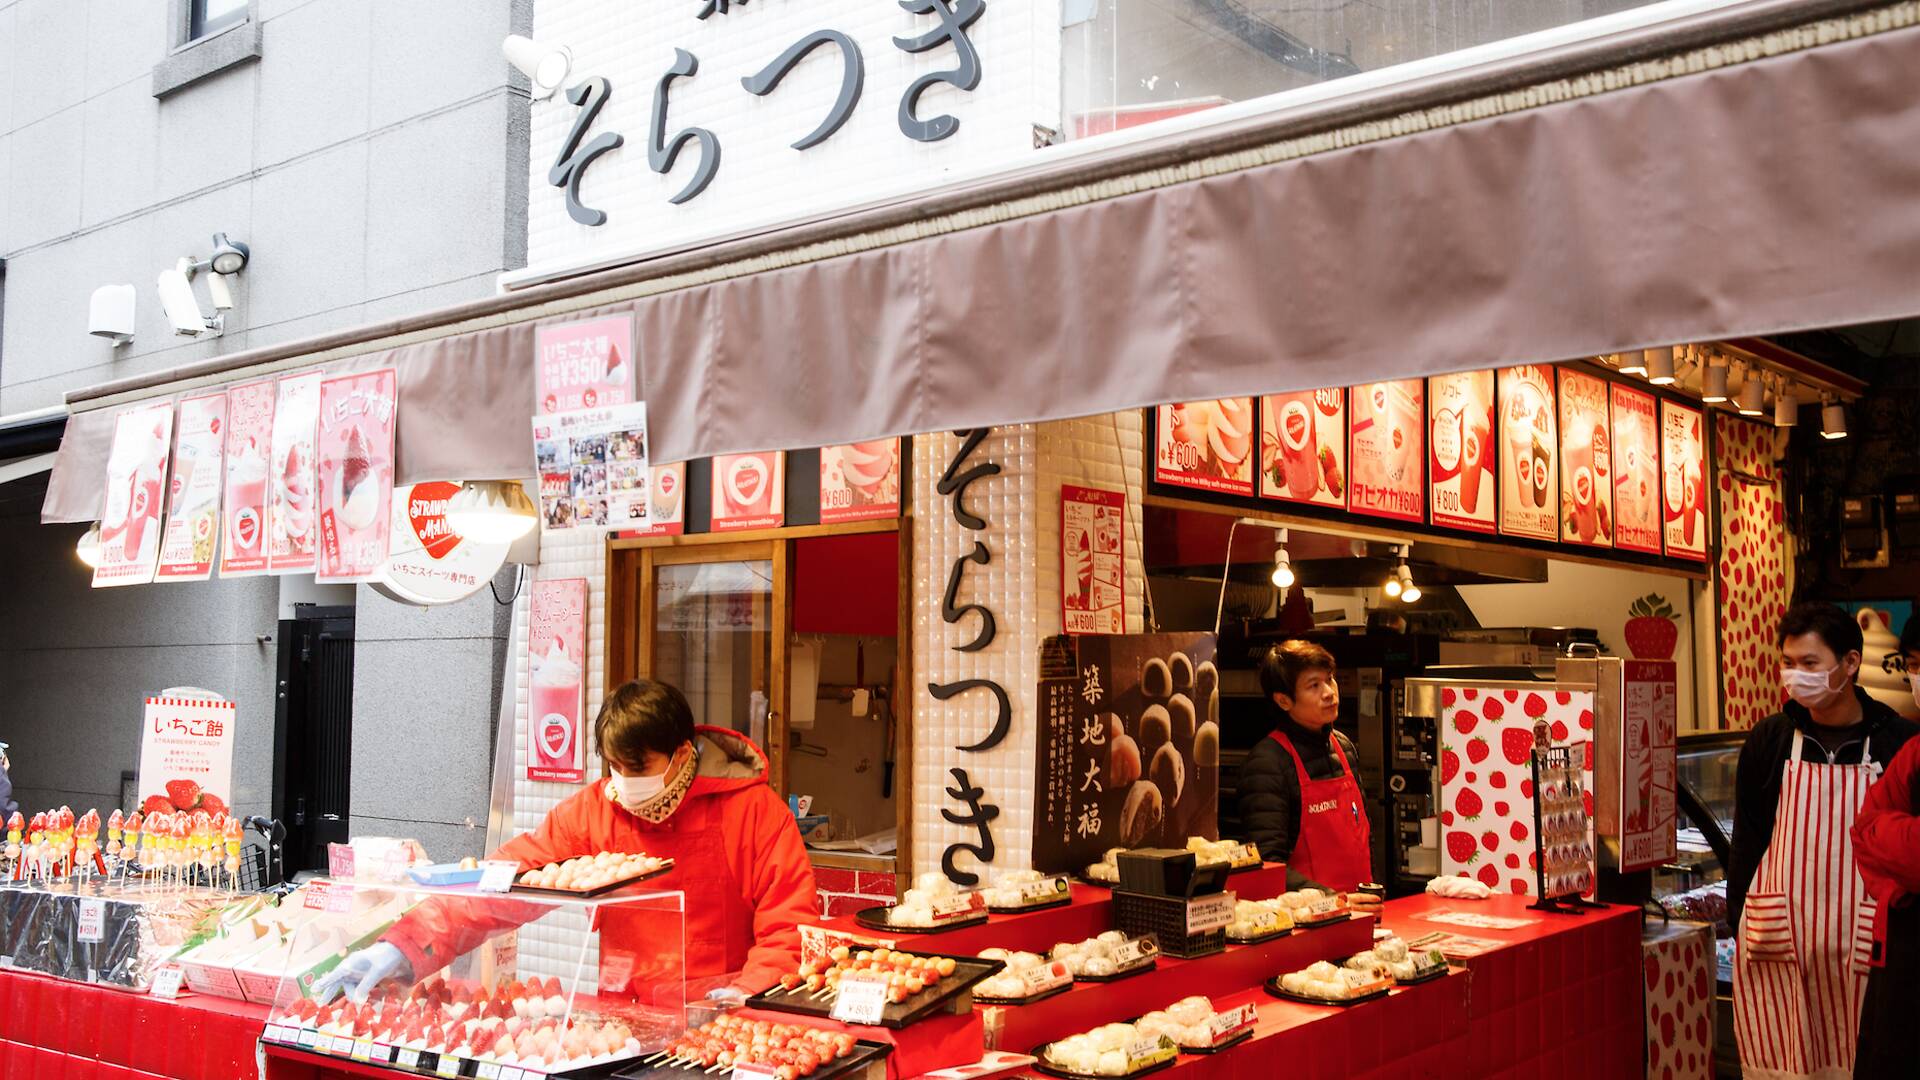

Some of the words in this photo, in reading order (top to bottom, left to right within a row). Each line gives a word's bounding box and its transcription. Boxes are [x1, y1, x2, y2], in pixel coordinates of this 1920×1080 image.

[548, 0, 985, 227] そらつき
[1158, 472, 1184, 484] Strawberry
[1436, 487, 1459, 512] ¥800
[720, 520, 748, 529] Strawberry
[392, 563, 477, 586] いちごスイーツ専門店
[928, 427, 1012, 886] そらつき
[155, 717, 224, 737] いちご飴
[1077, 663, 1106, 839] 築地大福
